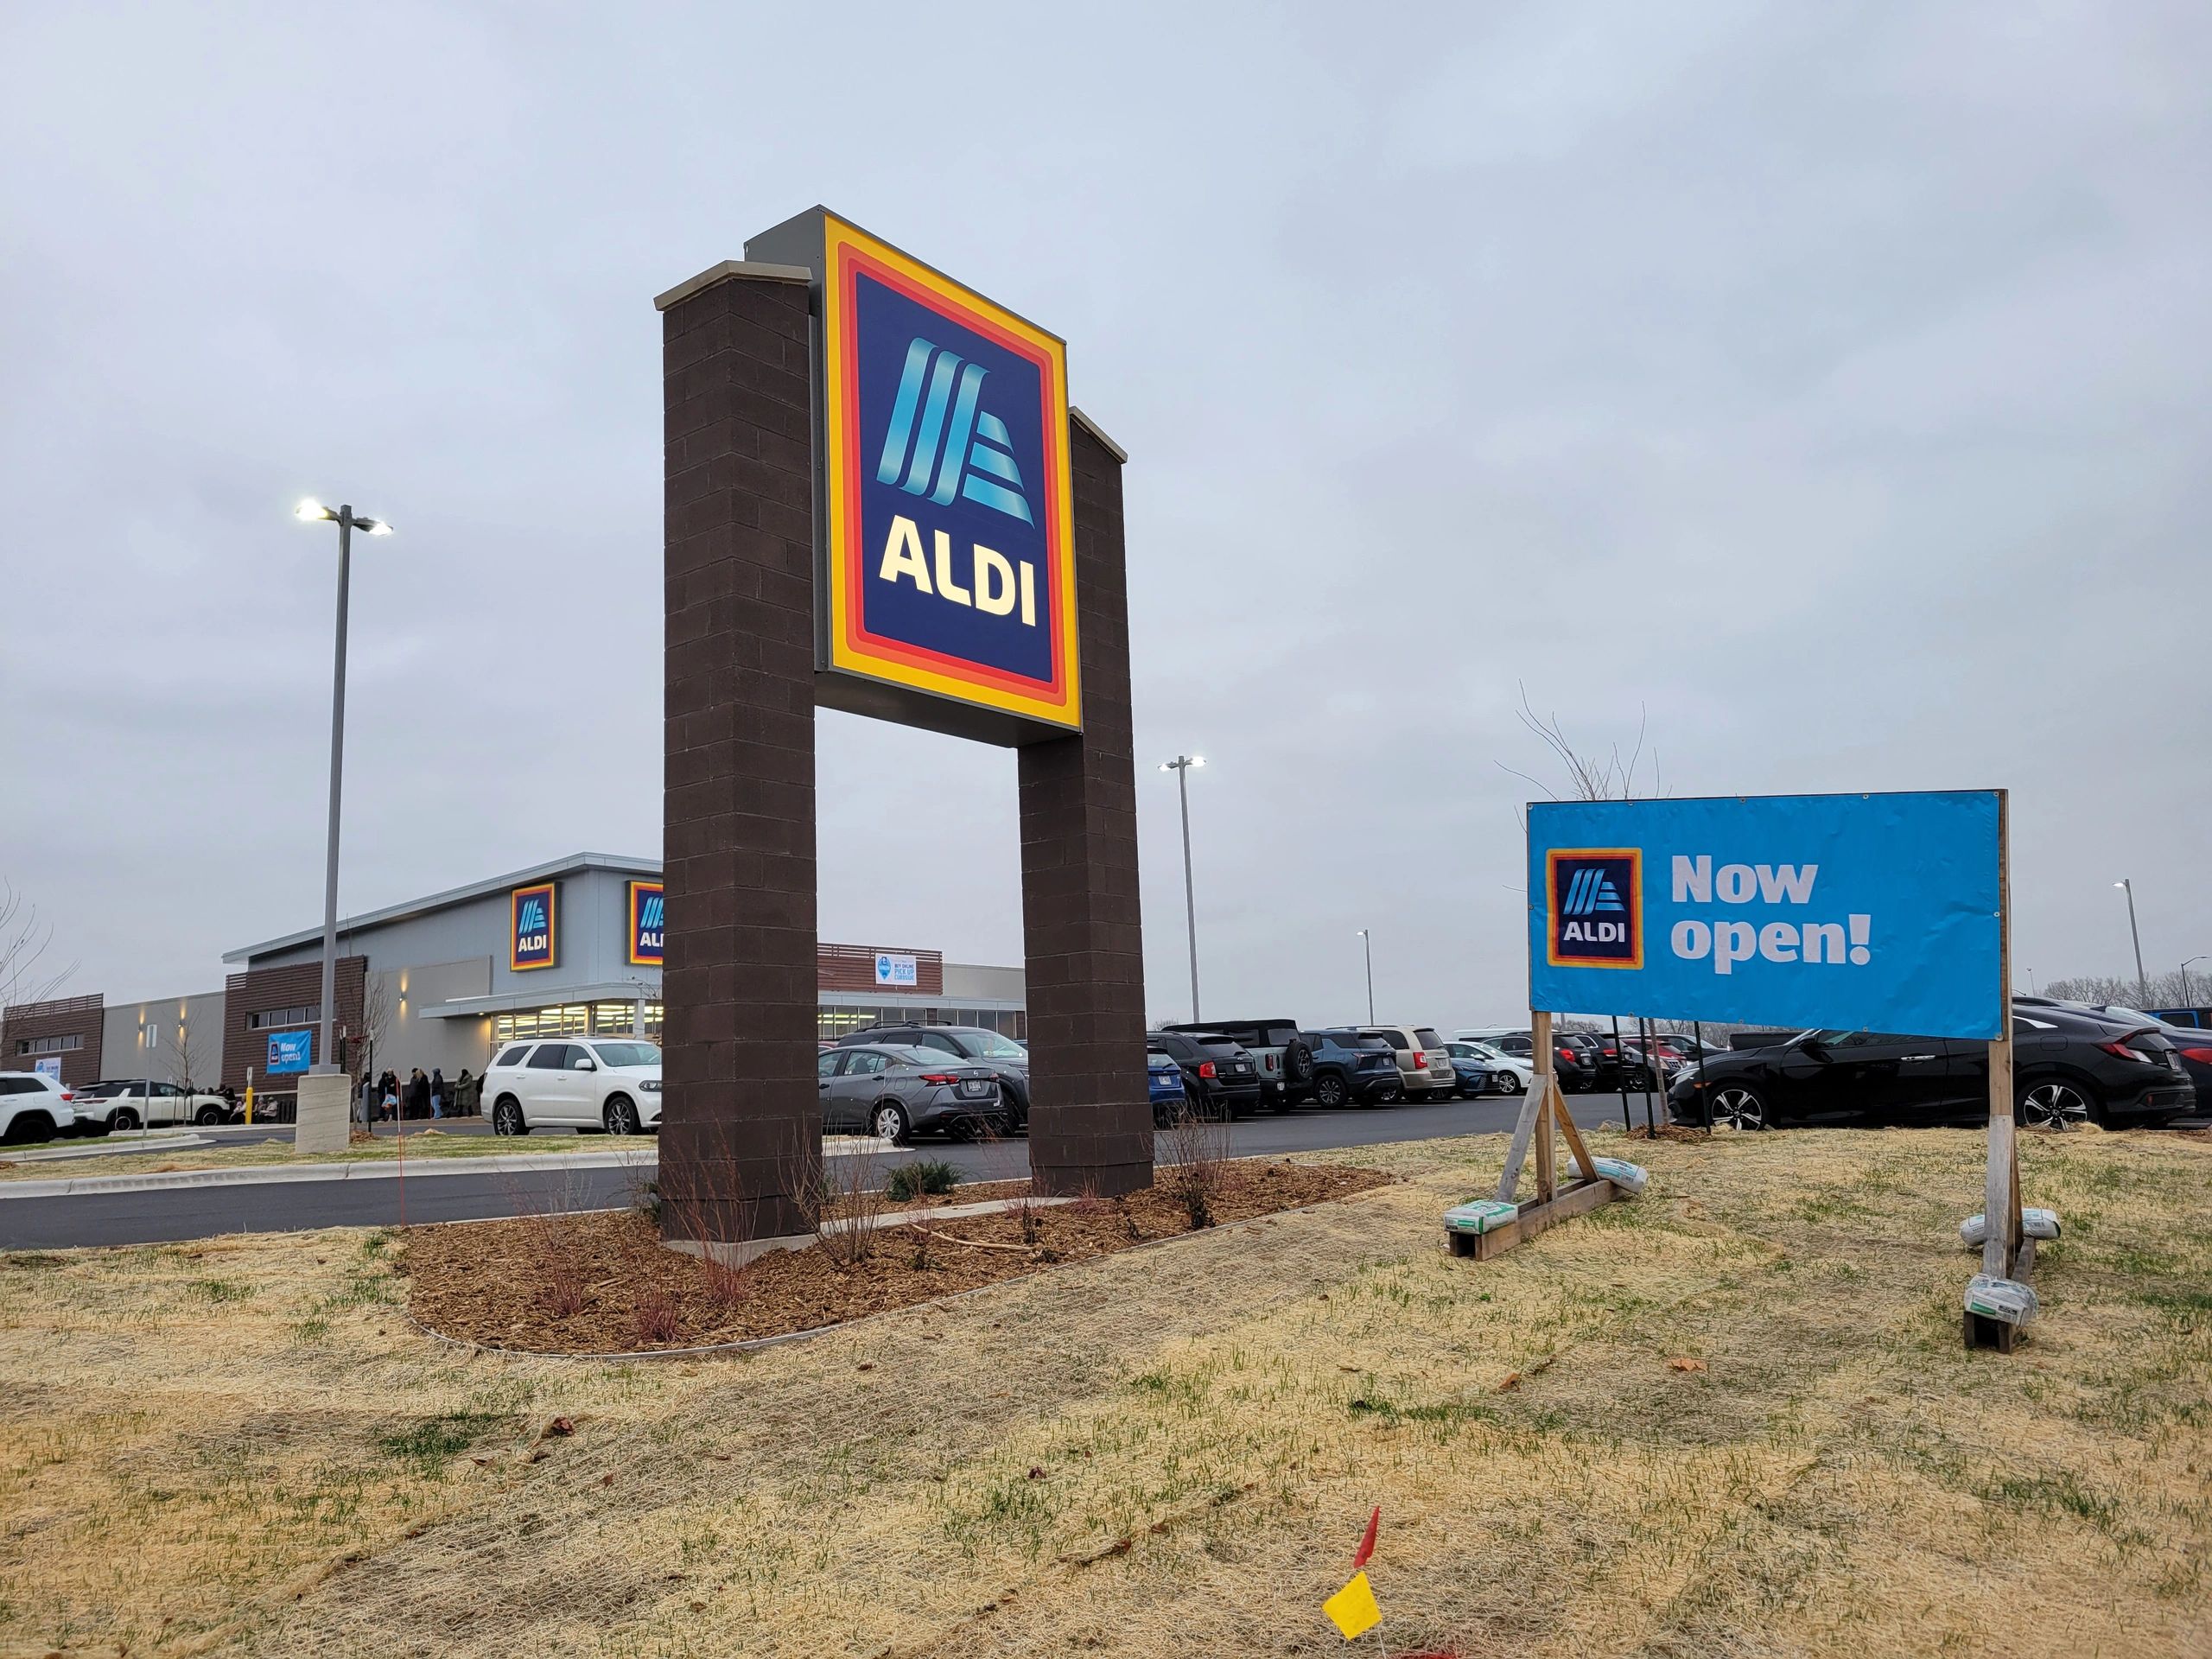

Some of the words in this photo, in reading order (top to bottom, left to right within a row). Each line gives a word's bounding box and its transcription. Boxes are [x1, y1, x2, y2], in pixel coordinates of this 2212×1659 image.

[879, 514, 1036, 627] ALDI
[1672, 855, 1818, 904] Now
[639, 931, 664, 948] AL
[1563, 922, 1625, 943] ALDI
[518, 934, 547, 952] ALDI
[1671, 913, 1872, 975] open!
[281, 1043, 296, 1052] Now
[281, 1052, 301, 1065] open!
